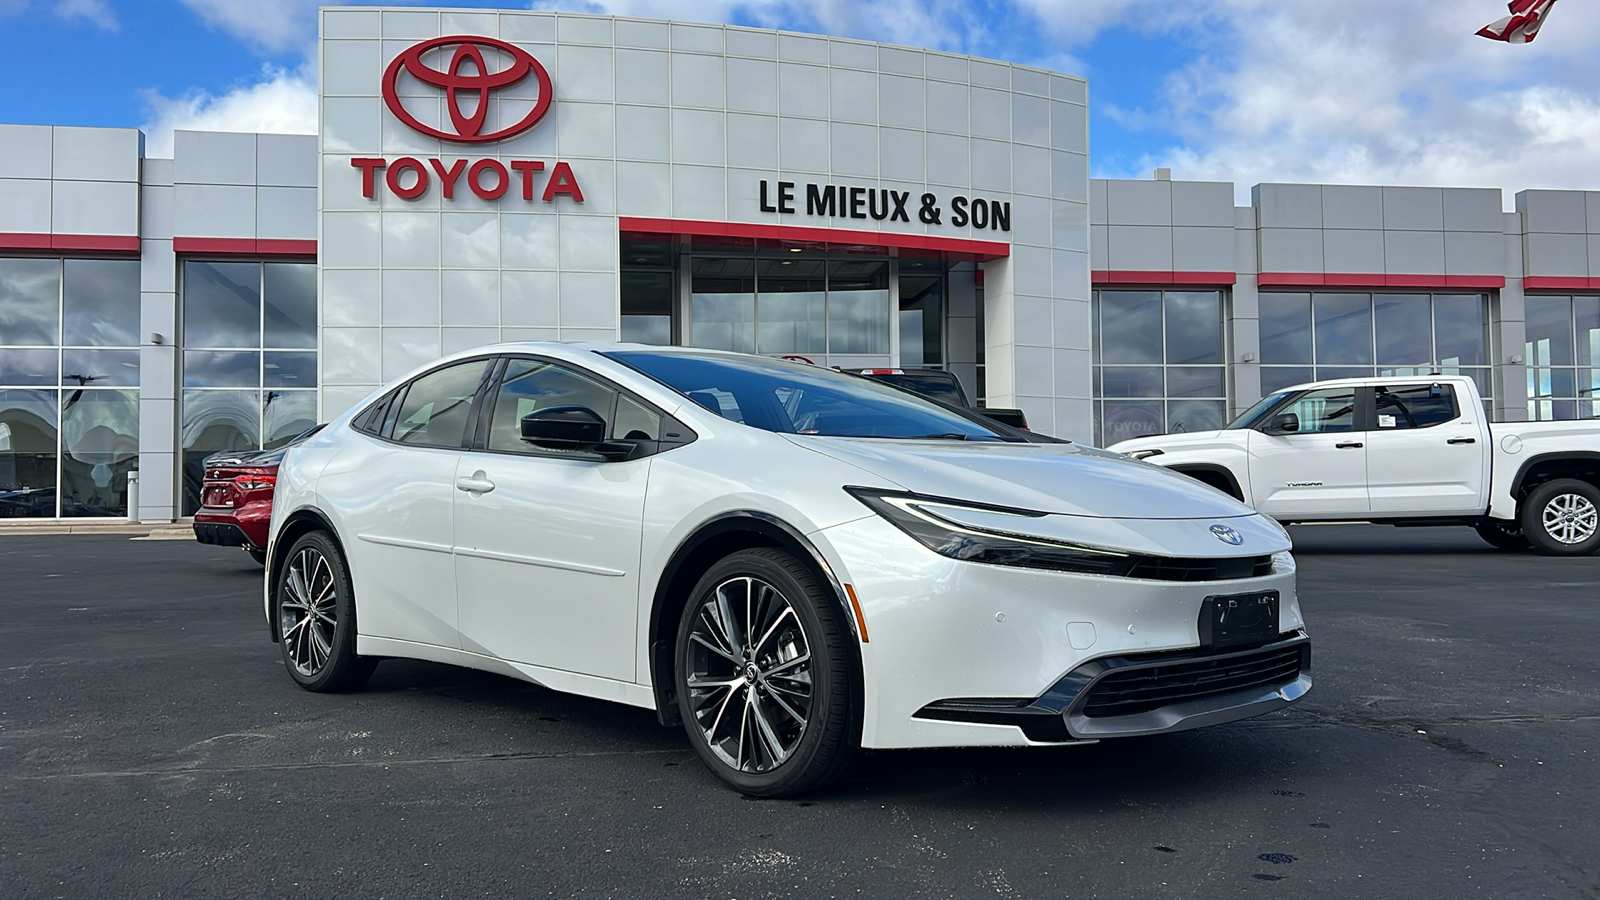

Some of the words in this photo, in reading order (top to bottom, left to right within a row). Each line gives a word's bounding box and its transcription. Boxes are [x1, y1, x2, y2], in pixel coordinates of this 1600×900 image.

[351, 157, 584, 202] TOYOTA
[760, 180, 795, 214] LE
[807, 183, 910, 222] MIEUX
[918, 193, 942, 225] &
[951, 196, 1011, 231] SON
[1107, 421, 1158, 433] TOYOTA
